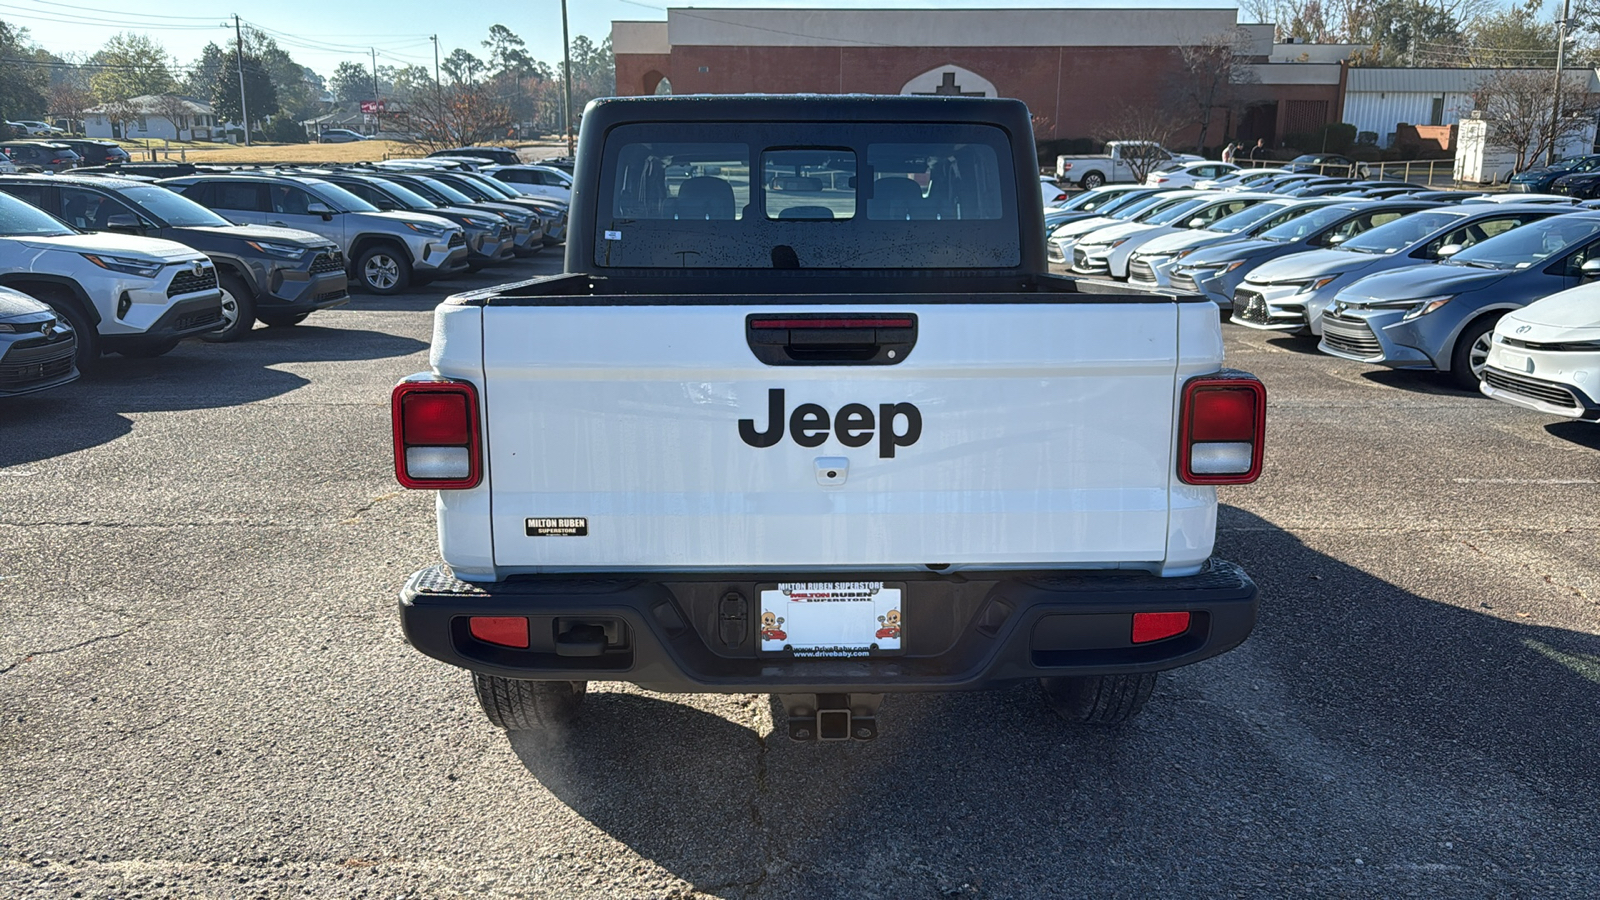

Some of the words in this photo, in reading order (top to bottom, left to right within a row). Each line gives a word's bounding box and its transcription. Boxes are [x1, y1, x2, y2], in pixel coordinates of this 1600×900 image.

[738, 388, 922, 458] Jeep
[528, 519, 557, 528] MILTON
[558, 519, 585, 528] RUBEN
[778, 582, 806, 591] MILTON
[808, 582, 833, 591] RUBEN
[834, 581, 884, 590] SUPERSTORE
[793, 650, 870, 658] www.drivebaby.com
